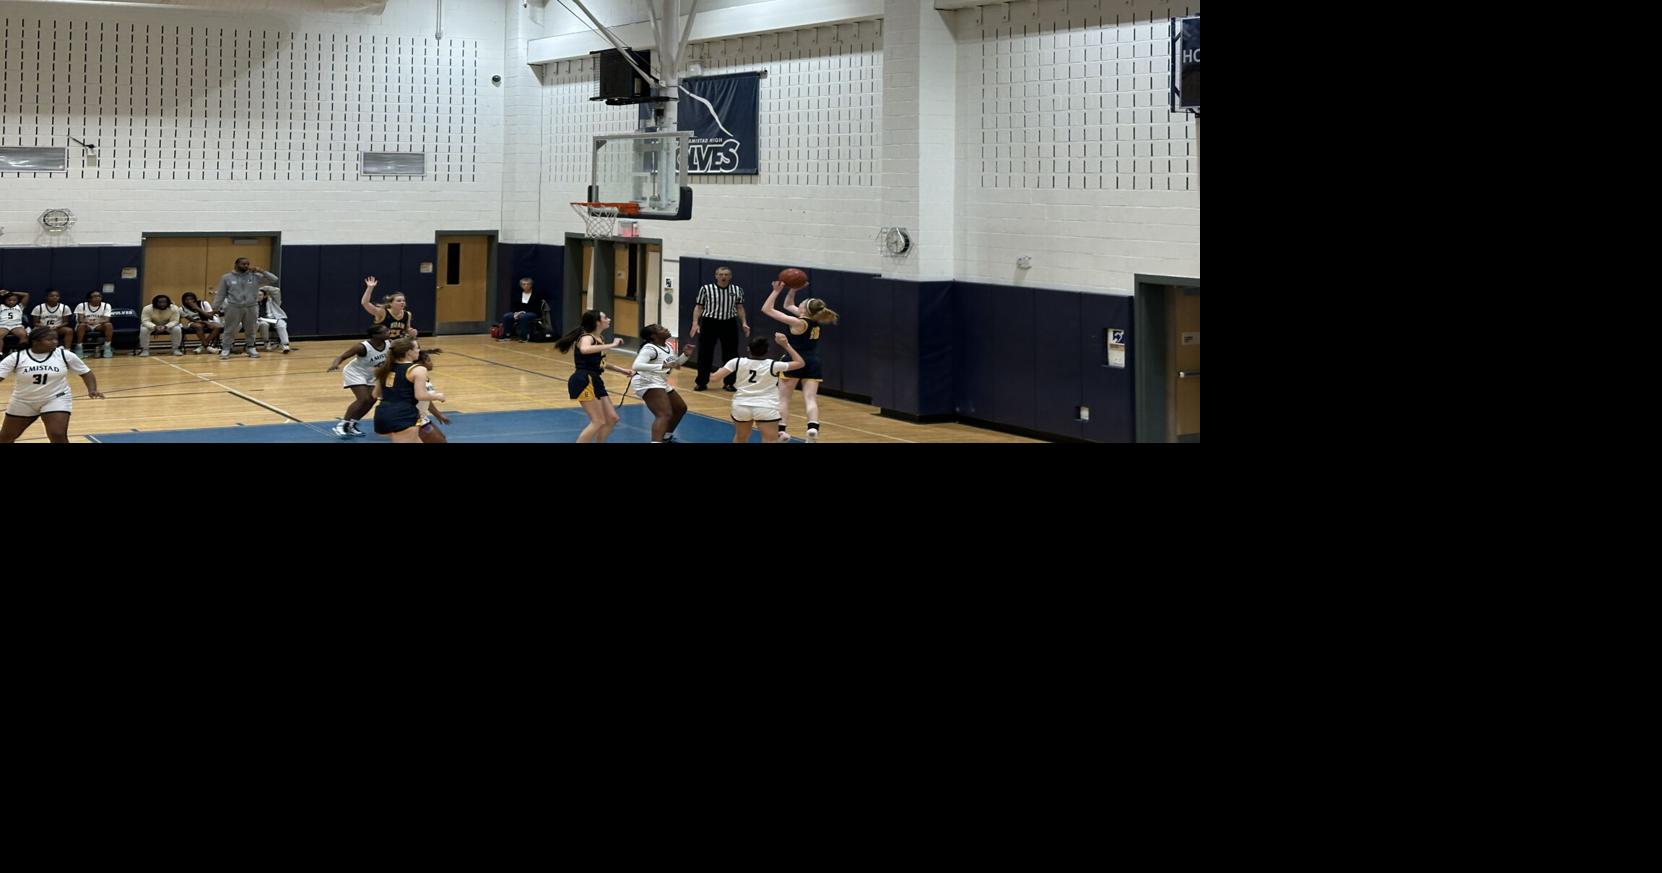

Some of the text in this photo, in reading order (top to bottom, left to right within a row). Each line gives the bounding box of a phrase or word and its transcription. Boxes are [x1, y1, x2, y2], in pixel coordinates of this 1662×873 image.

[23, 365, 60, 373] AMISTAD
[32, 373, 48, 385] 31
[748, 369, 757, 383] 2
